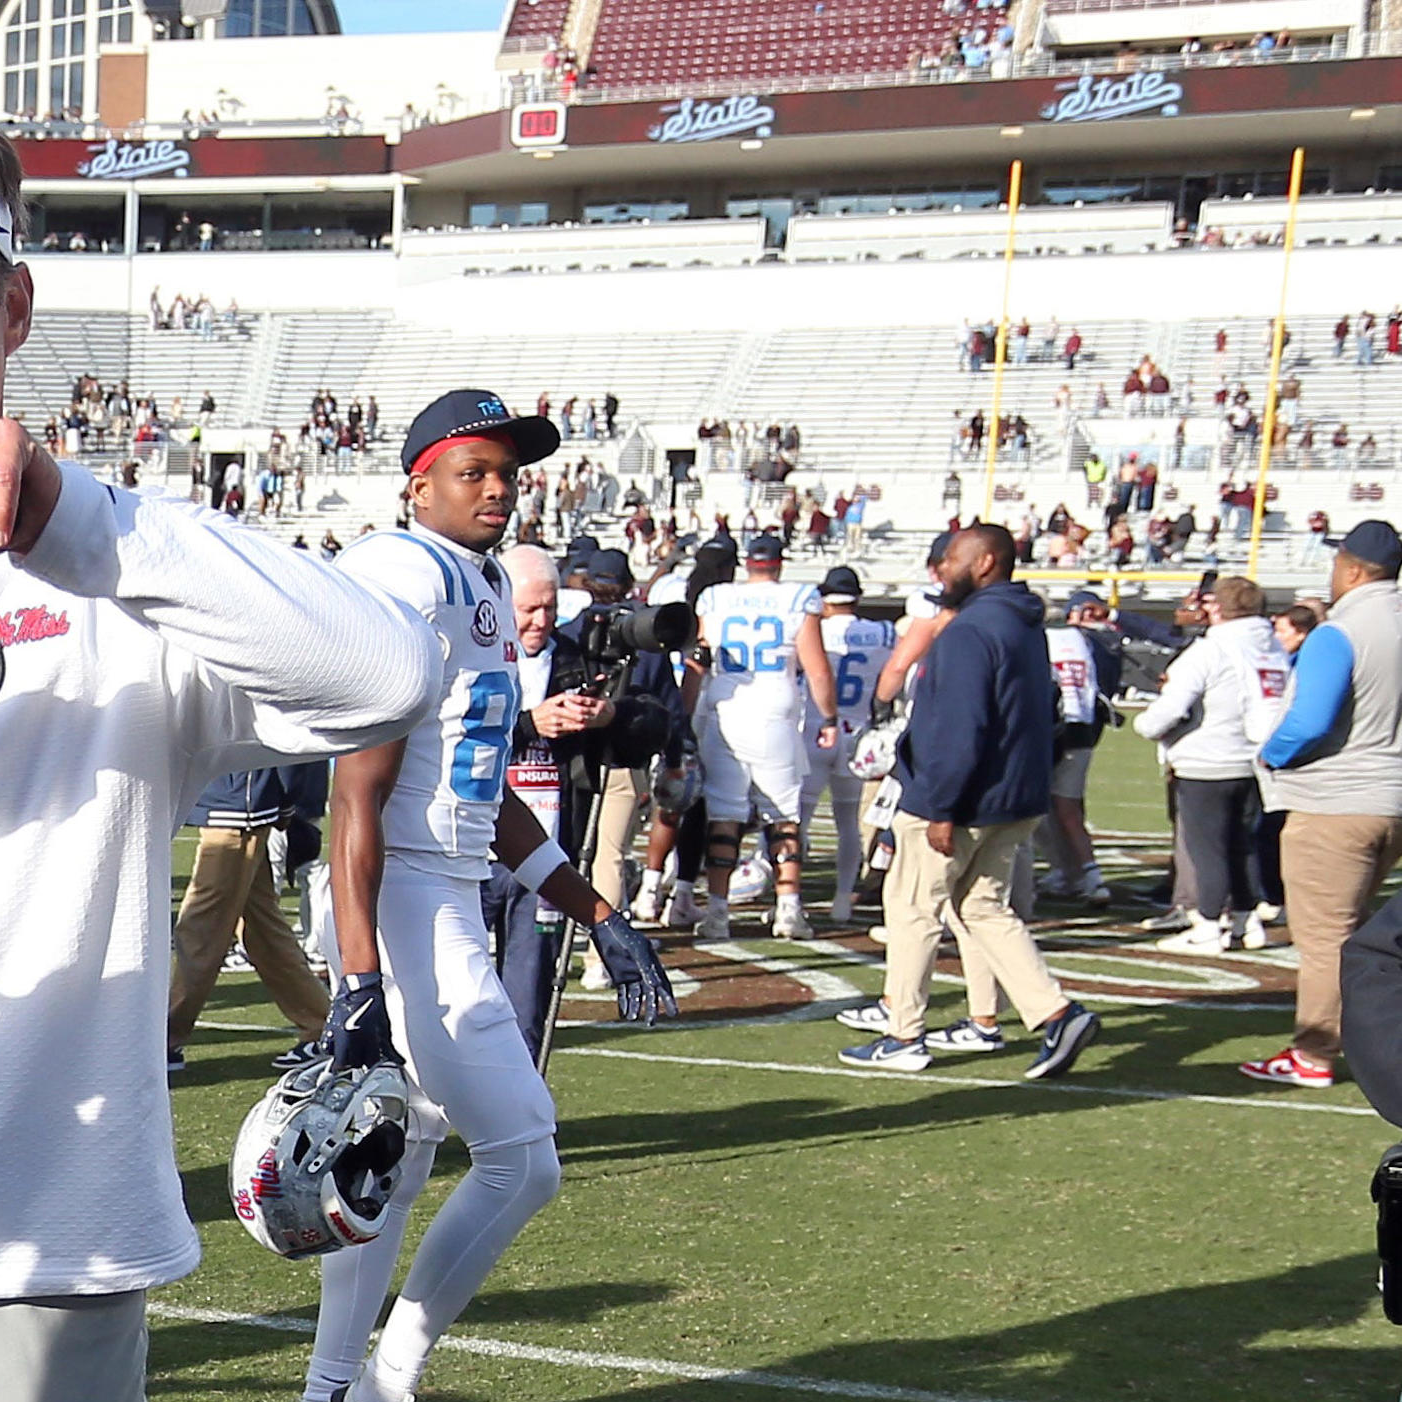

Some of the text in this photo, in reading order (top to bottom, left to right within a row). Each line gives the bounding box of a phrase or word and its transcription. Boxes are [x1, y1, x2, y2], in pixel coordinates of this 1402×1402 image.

[659, 96, 774, 143] State
[1055, 73, 1183, 122] State
[86, 140, 190, 178] State
[15, 604, 71, 644] Miss
[720, 616, 787, 672] 62
[837, 652, 868, 707] 6
